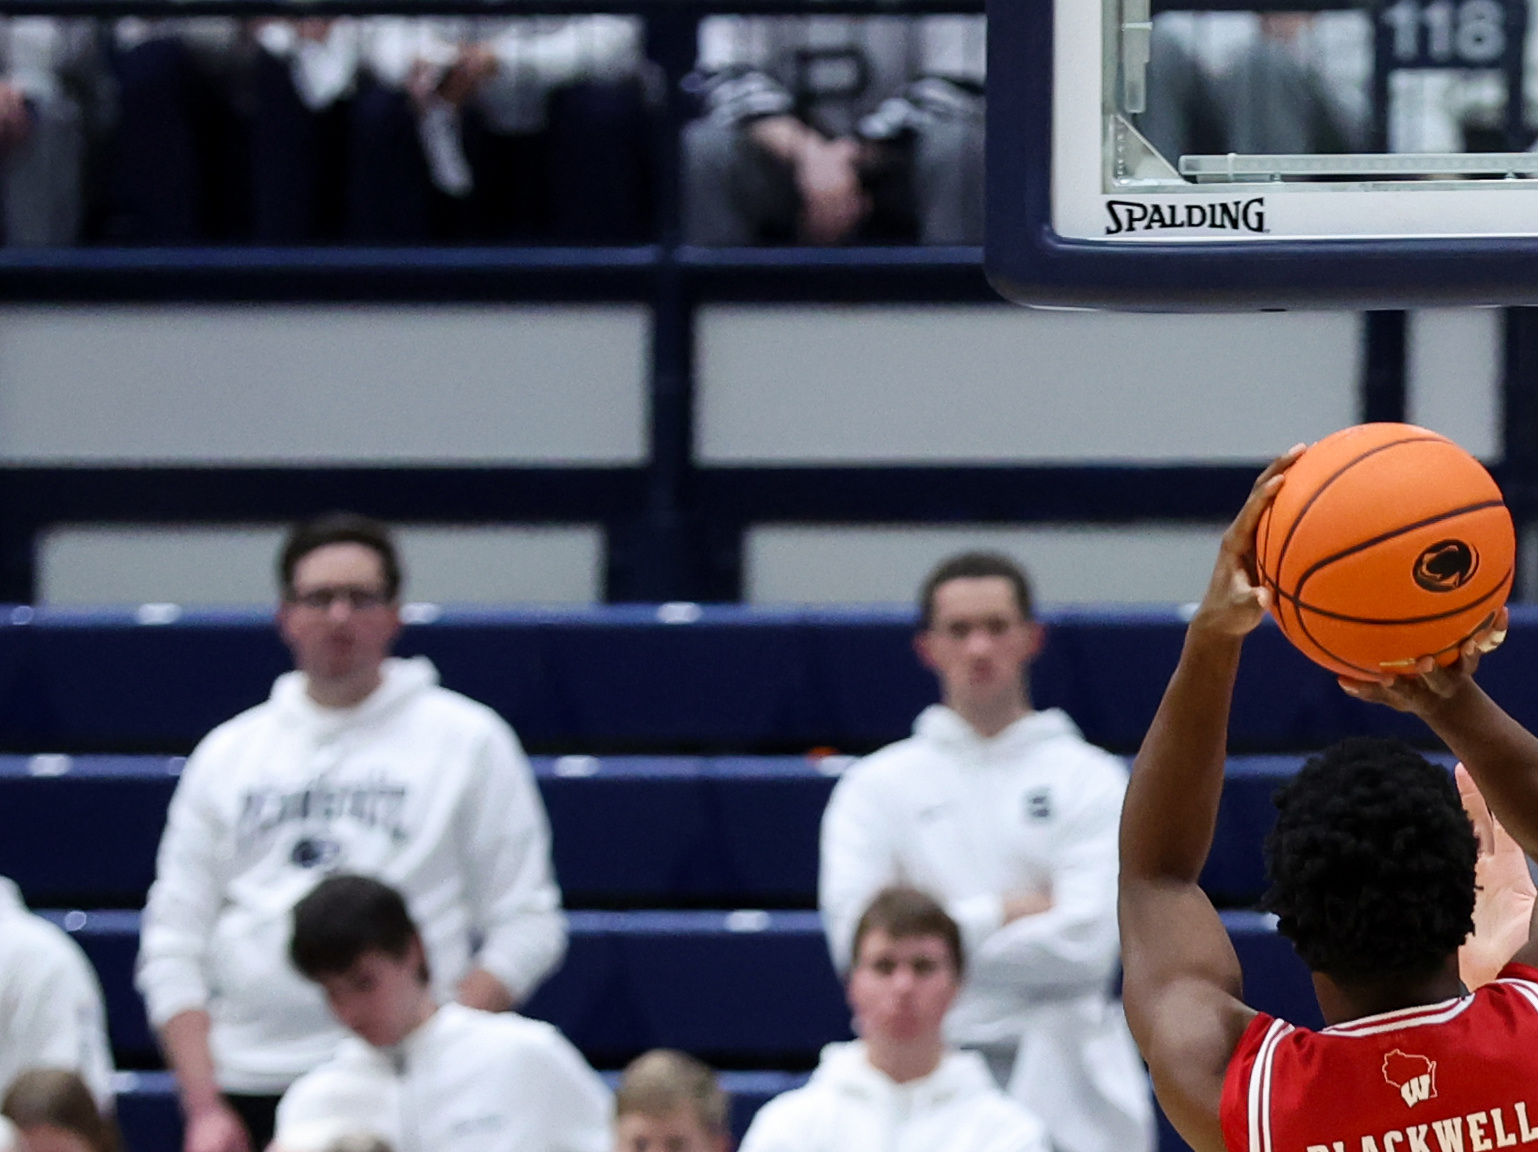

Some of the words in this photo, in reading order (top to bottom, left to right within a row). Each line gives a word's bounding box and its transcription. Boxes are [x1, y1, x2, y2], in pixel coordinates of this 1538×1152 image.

[1380, 0, 1506, 62] 118
[1105, 197, 1266, 235] SPALDING
[1400, 1074, 1431, 1108] W
